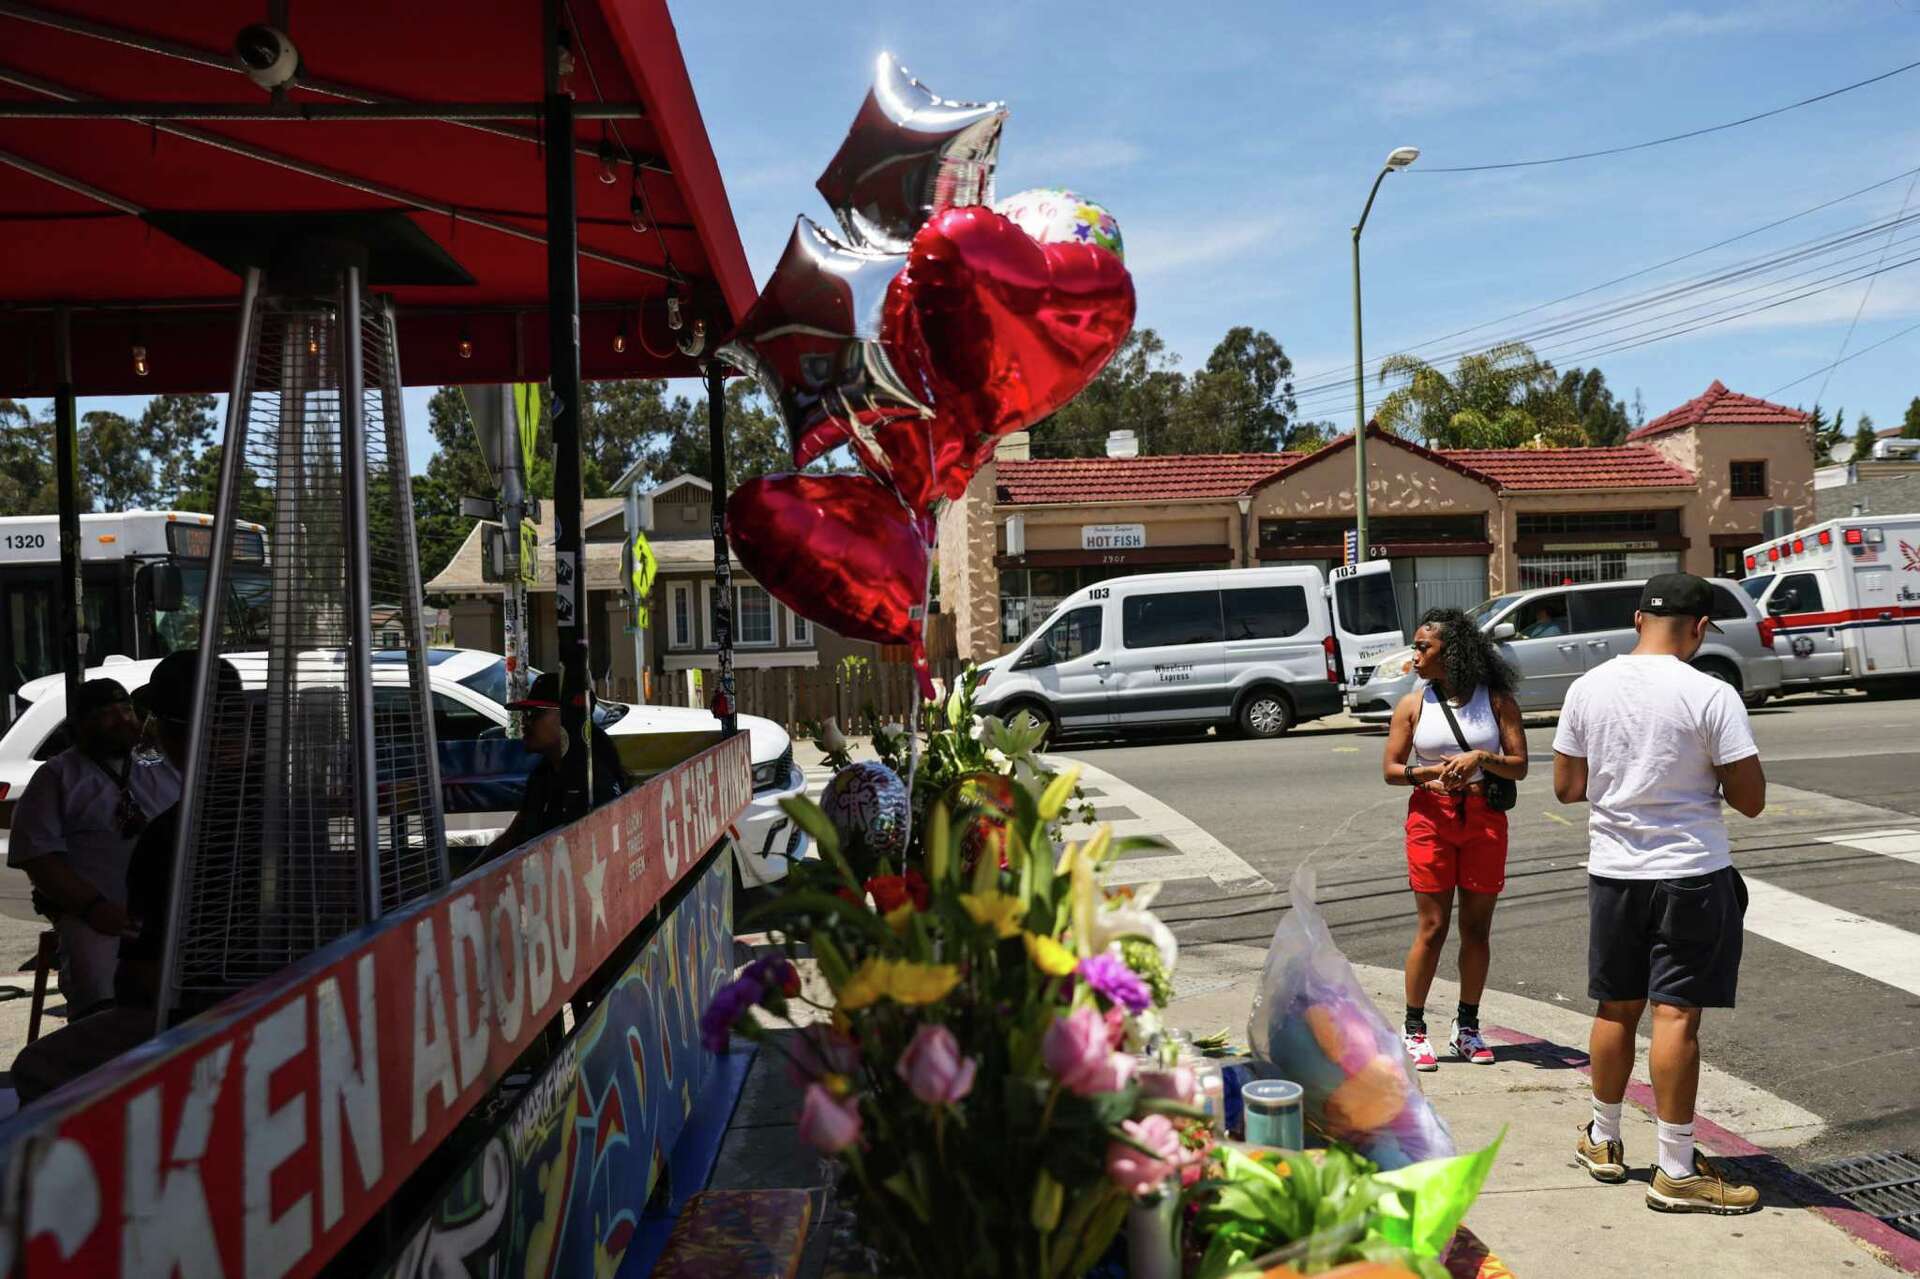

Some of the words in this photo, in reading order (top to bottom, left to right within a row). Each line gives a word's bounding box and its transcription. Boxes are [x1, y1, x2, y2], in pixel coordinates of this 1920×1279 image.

[5, 535, 45, 549] 1320
[1087, 535, 1111, 548] HOT
[1113, 534, 1141, 547] FISH
[1335, 565, 1357, 579] 103
[1088, 588, 1110, 600] 103
[681, 755, 717, 863] FIRE
[411, 836, 576, 1143] ADOBO
